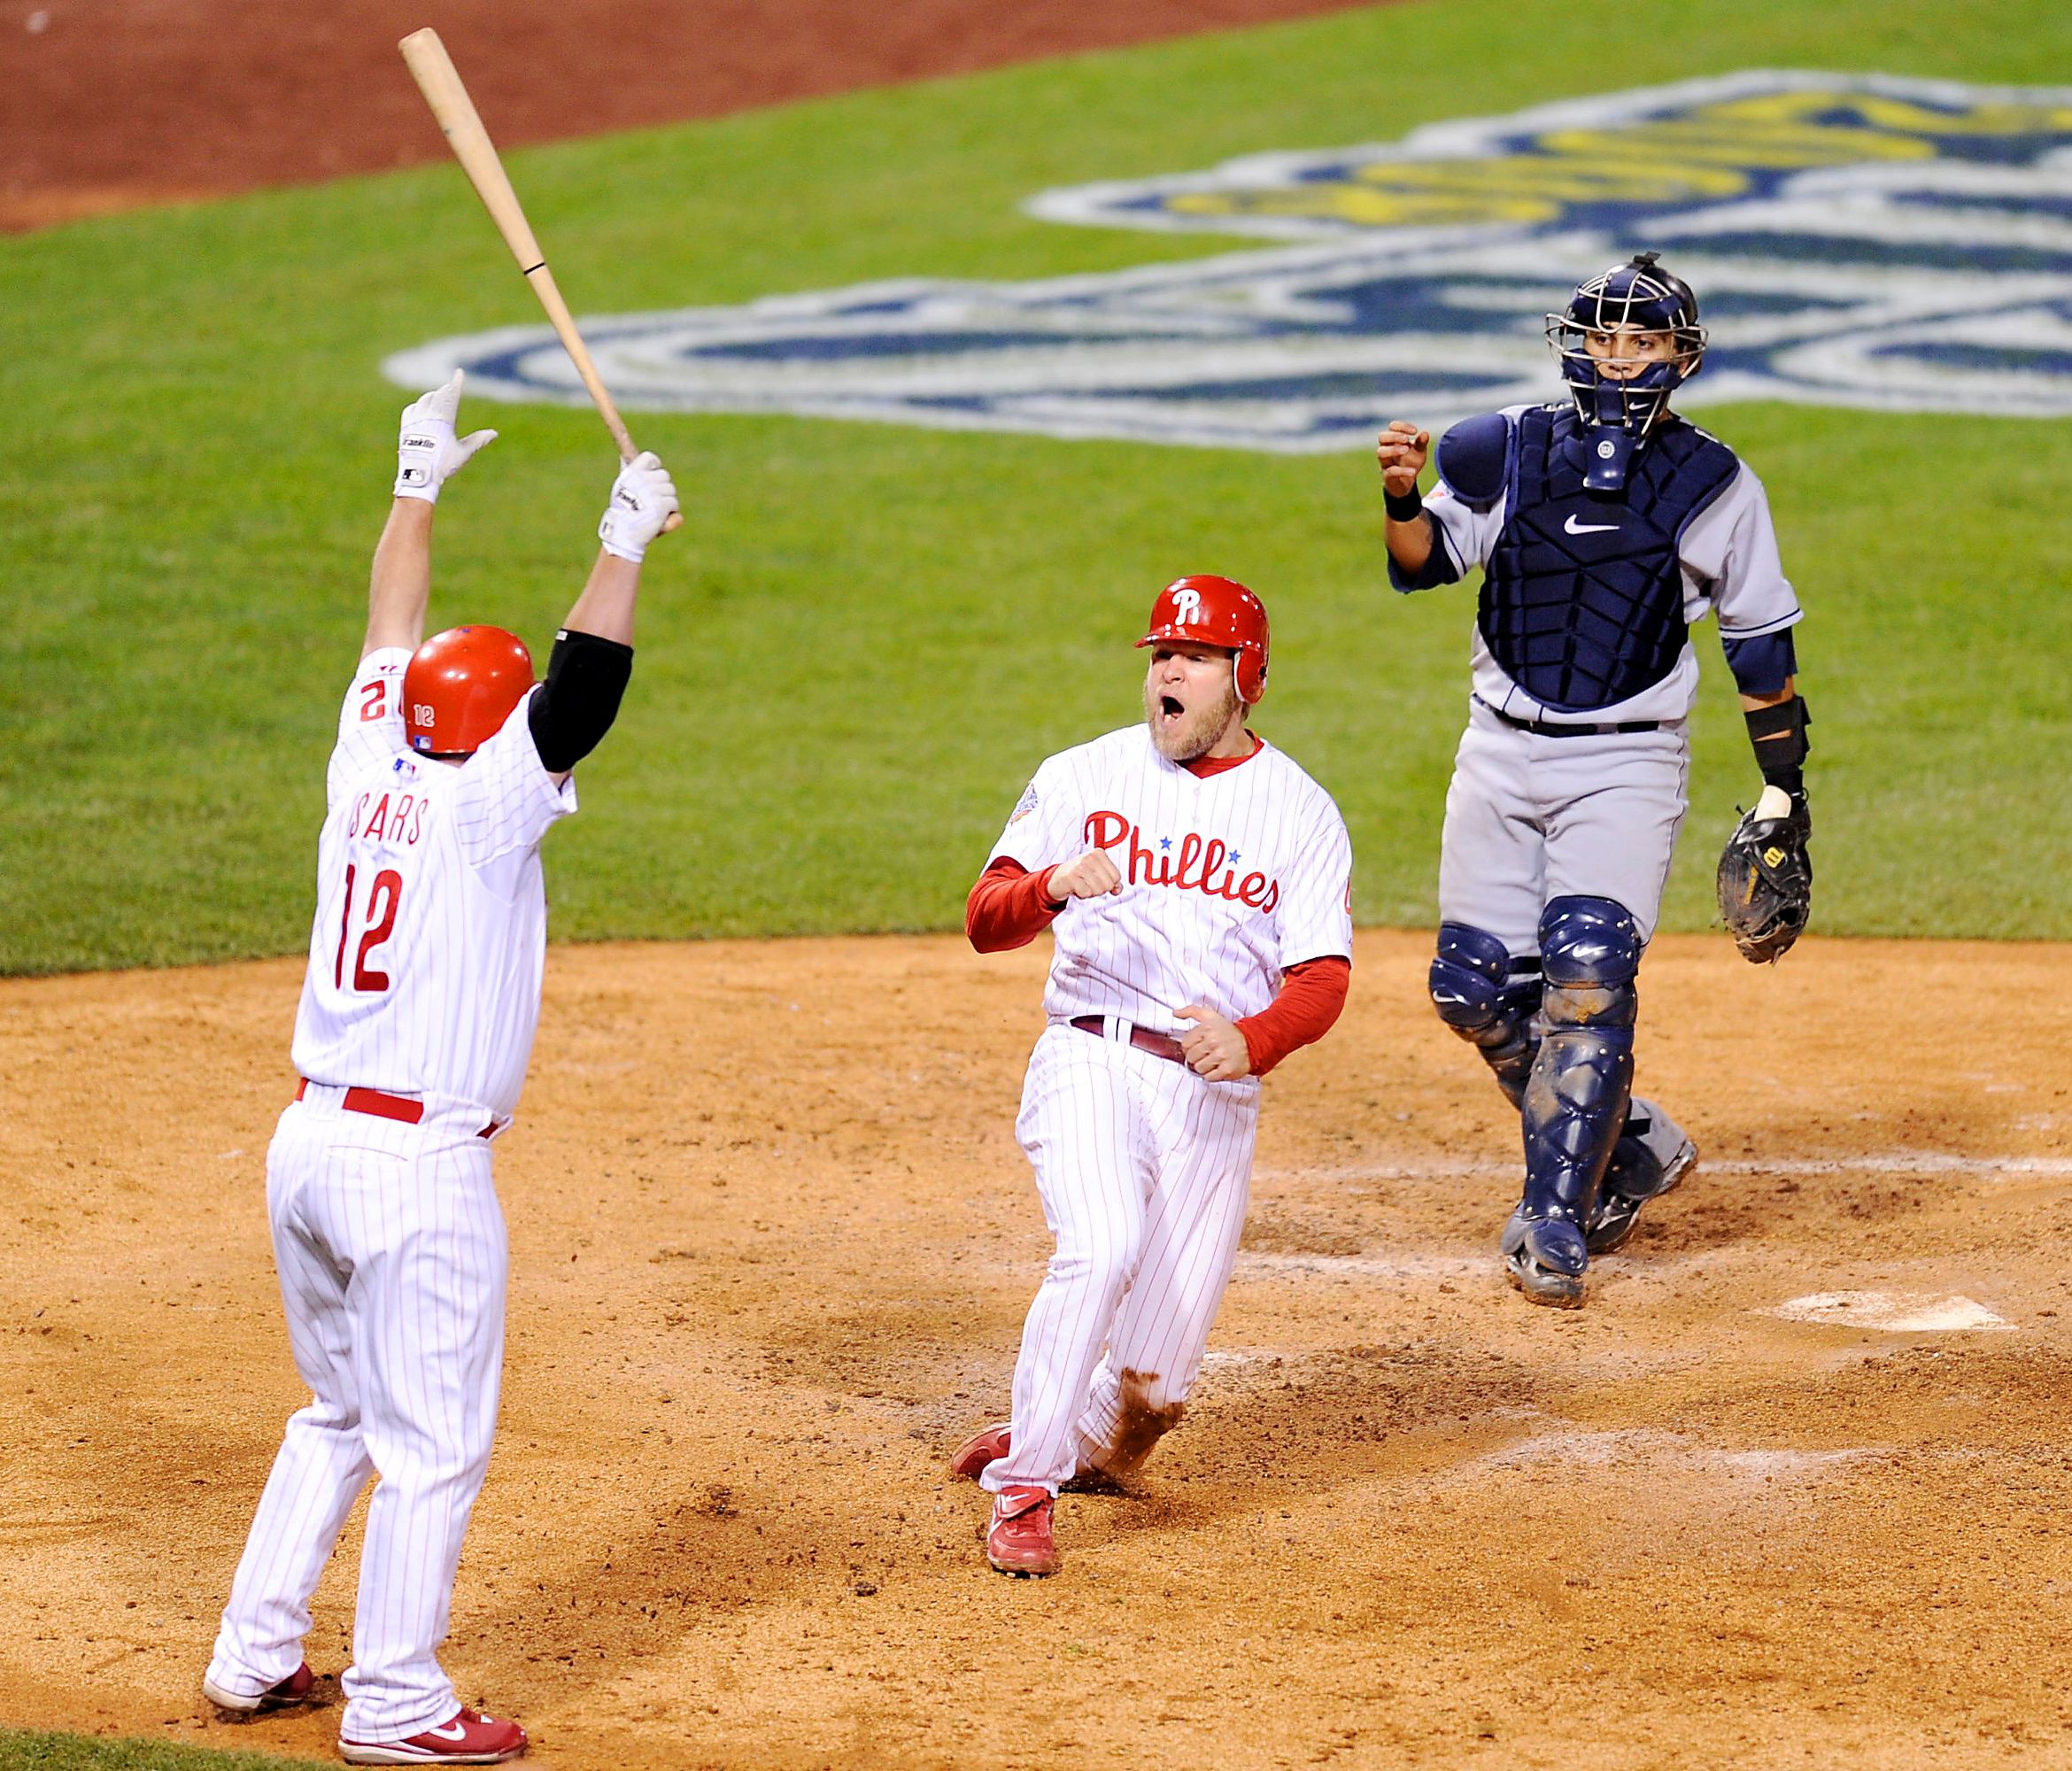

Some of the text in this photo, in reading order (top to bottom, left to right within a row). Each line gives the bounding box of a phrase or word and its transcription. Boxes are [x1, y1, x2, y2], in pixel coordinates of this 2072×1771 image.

[1171, 588, 1202, 625] P
[414, 704, 435, 727] 12
[1084, 810, 1280, 914] Phillies
[335, 863, 403, 992] 12
